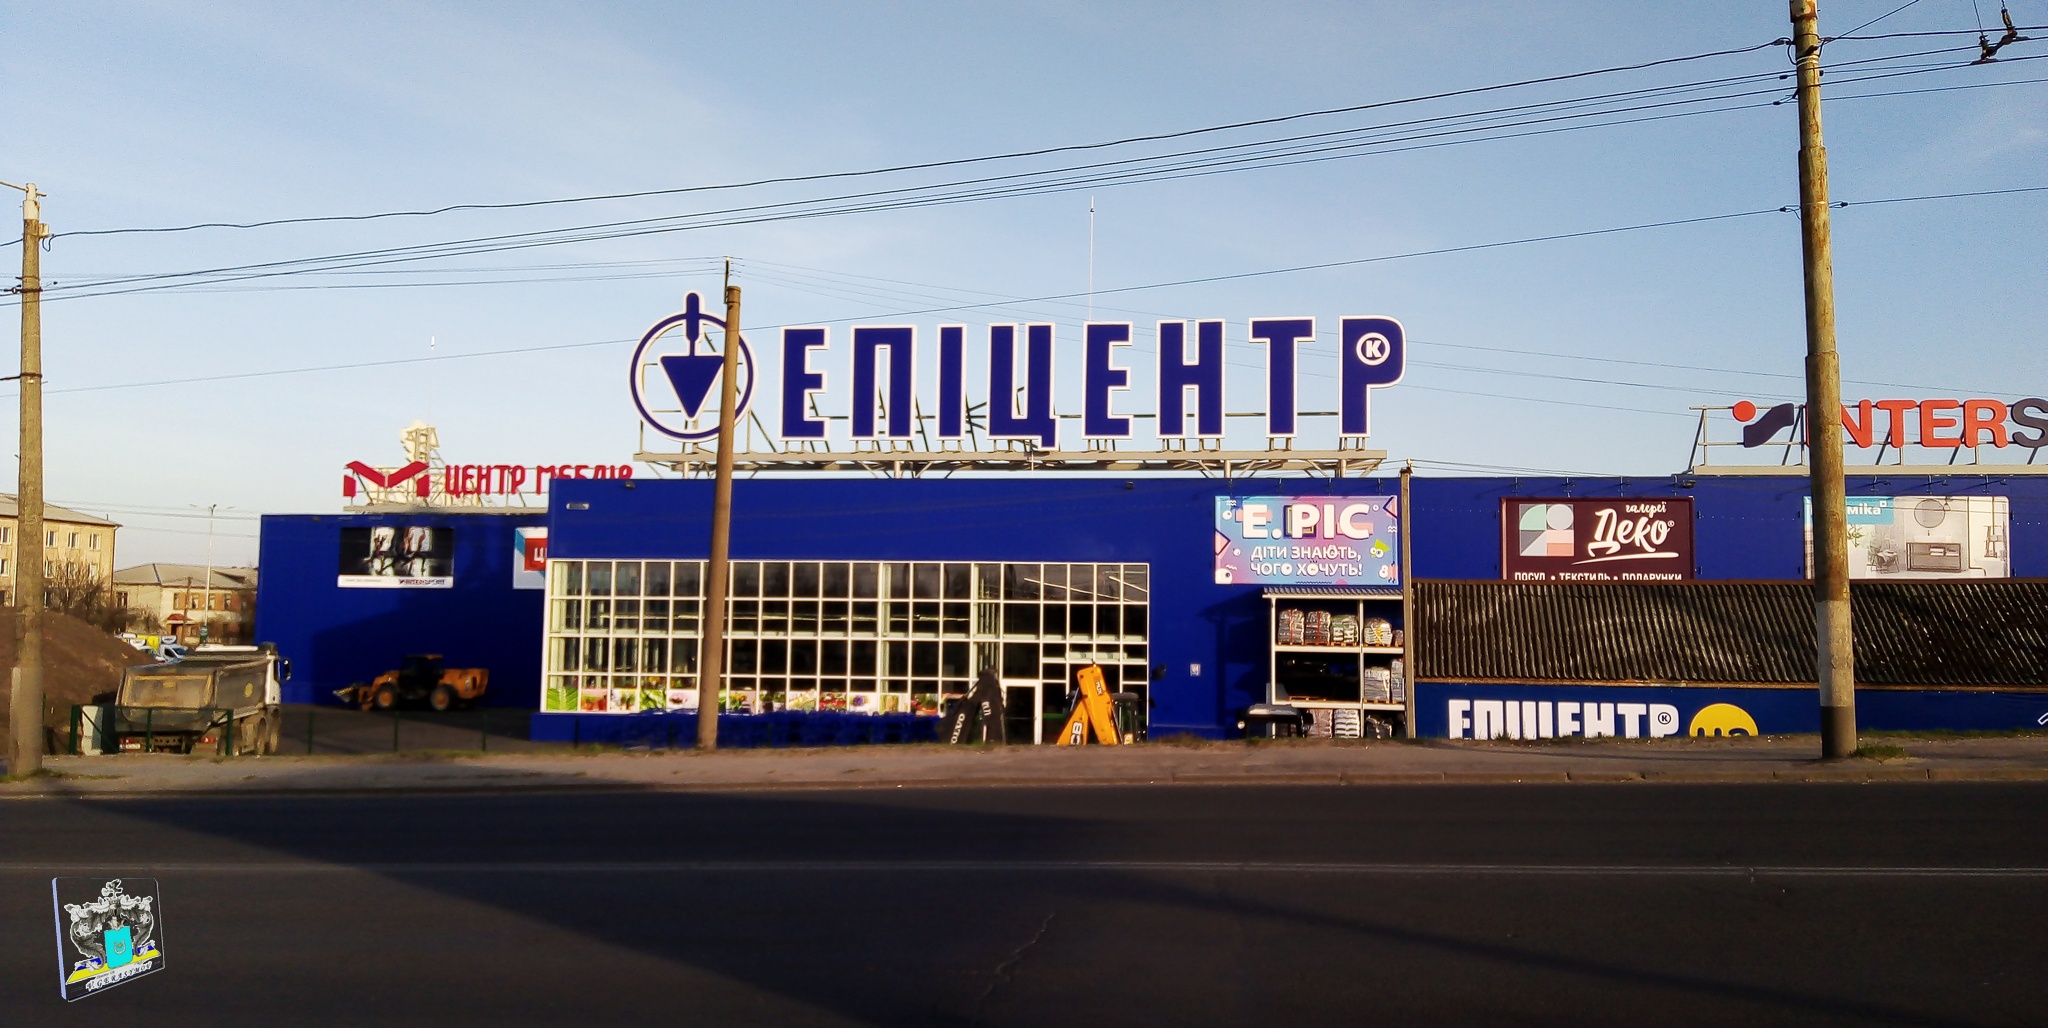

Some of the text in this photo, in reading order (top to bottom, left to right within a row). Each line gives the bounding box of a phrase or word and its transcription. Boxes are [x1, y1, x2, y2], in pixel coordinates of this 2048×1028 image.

[779, 315, 1407, 453] ЕПІЦЕНТР
[1805, 398, 2048, 448] NTERS
[445, 464, 526, 498] ЦЕНТР
[1242, 504, 1370, 539] E.PIC
[1625, 501, 1667, 518] галереї
[1250, 545, 1362, 562] ДІТИ ЗНАЮТЬ,
[1250, 562, 1363, 577] ЧОГО ХОЧУТЬ!
[950, 713, 965, 744] OLVO
[1070, 721, 1082, 745] CB
